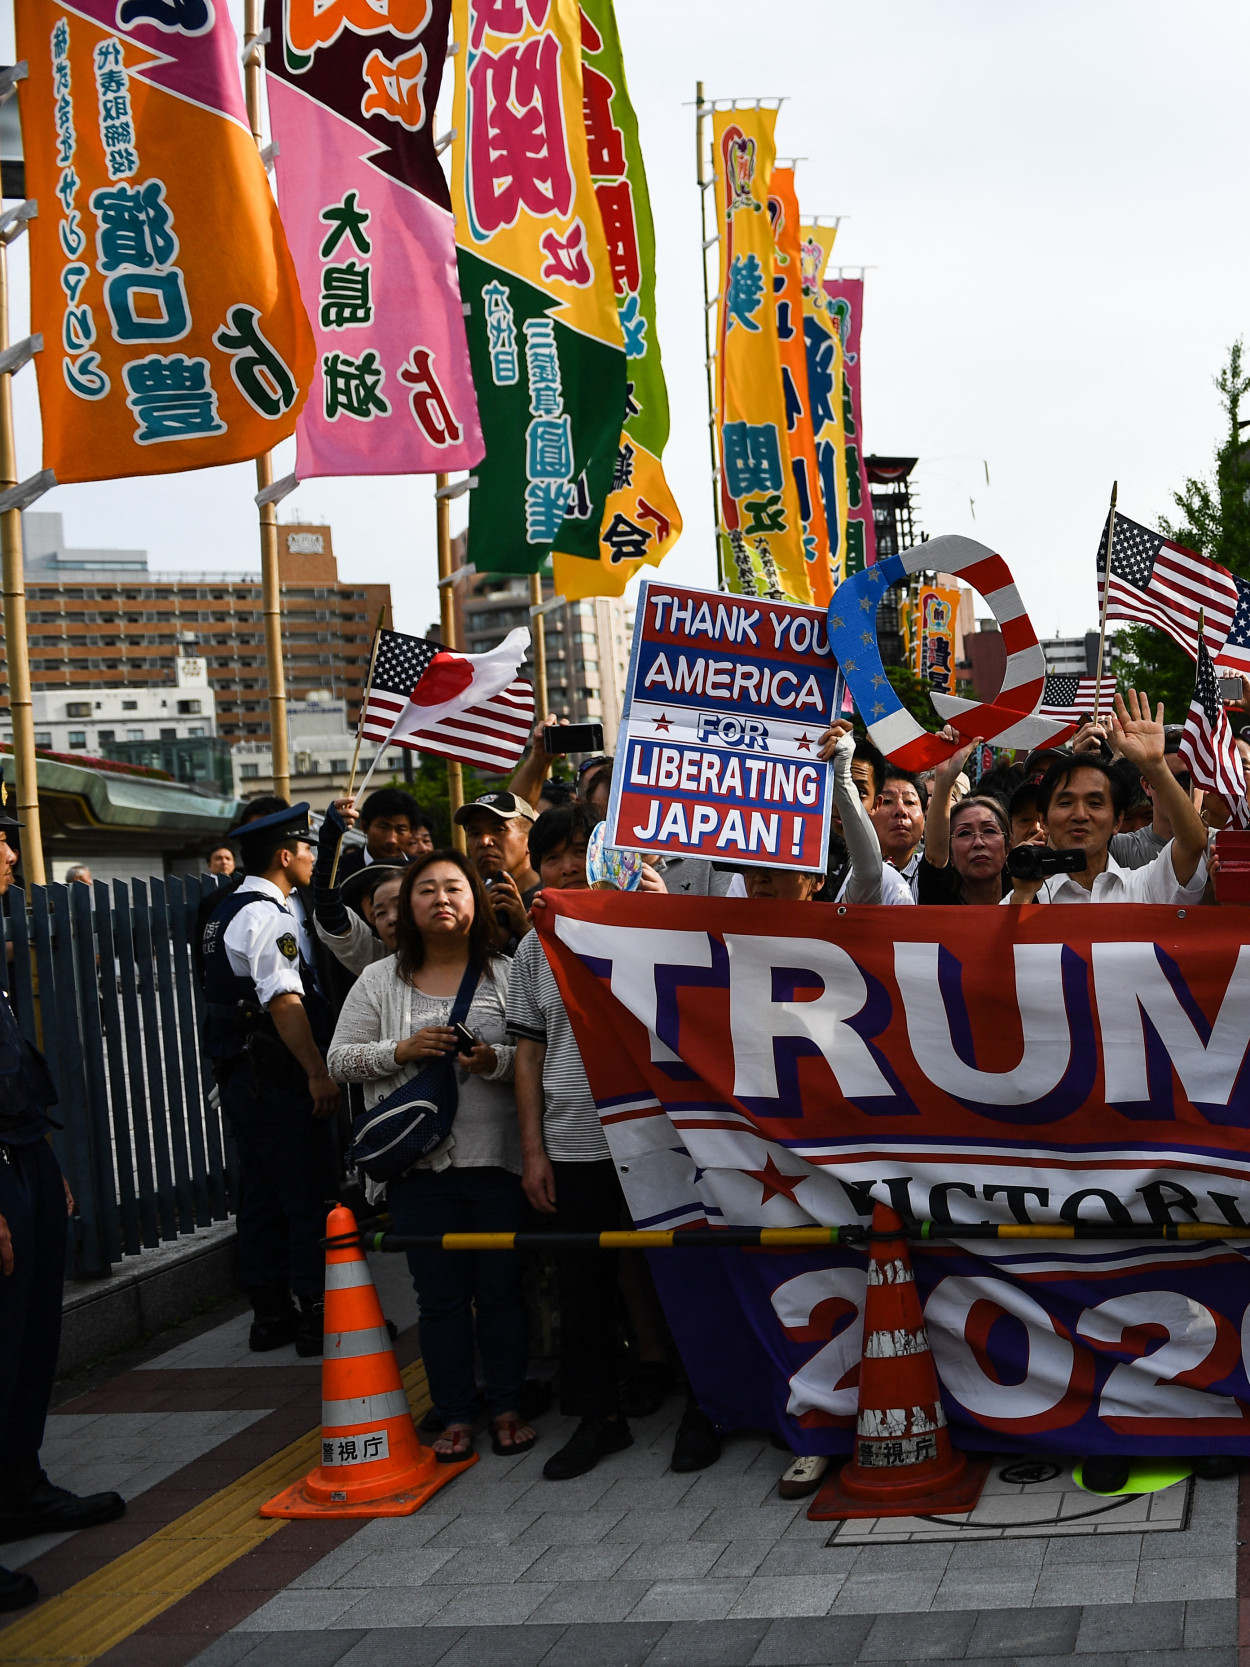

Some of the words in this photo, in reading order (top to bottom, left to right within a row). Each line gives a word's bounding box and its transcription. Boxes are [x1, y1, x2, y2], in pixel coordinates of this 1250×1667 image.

[650, 594, 760, 645] THANK
[769, 611, 831, 656] YOU
[644, 652, 825, 712] AMERICA
[697, 712, 769, 750] FOR
[630, 744, 818, 806] LIBERATING
[322, 1437, 383, 1462] 警視庁
[861, 1438, 932, 1465] 警視庁
